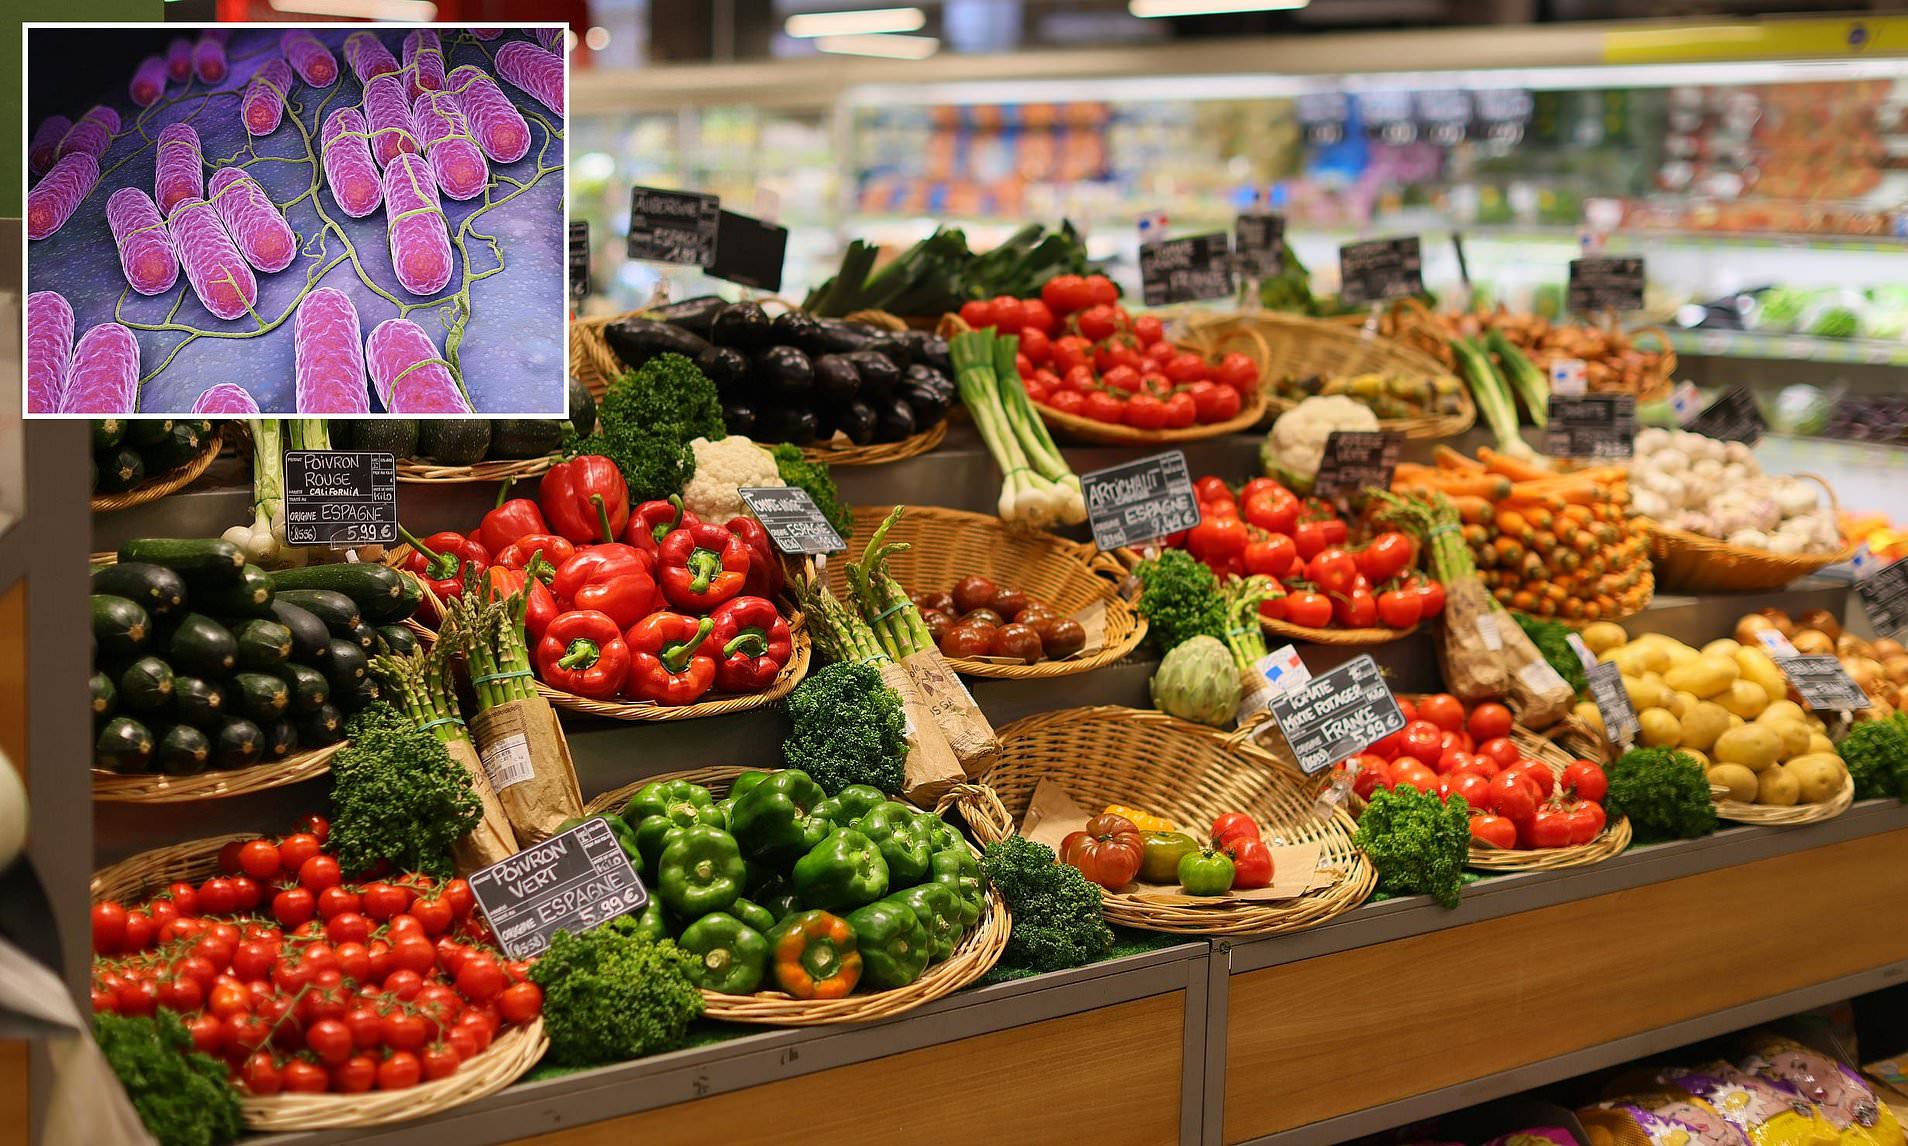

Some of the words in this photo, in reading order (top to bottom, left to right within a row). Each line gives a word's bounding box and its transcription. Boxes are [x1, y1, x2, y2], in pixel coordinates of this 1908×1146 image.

[304, 472, 351, 487] ROUGE
[290, 511, 317, 522] ORIGINE
[321, 504, 384, 522] ESPAGNE
[347, 524, 377, 542] 5,99
[380, 524, 392, 538] €
[1289, 679, 1334, 709] TOMATE
[1320, 705, 1379, 741] FRANCE
[508, 862, 558, 898] VERT
[537, 871, 625, 924] ESPAGNE
[623, 887, 640, 904] €
